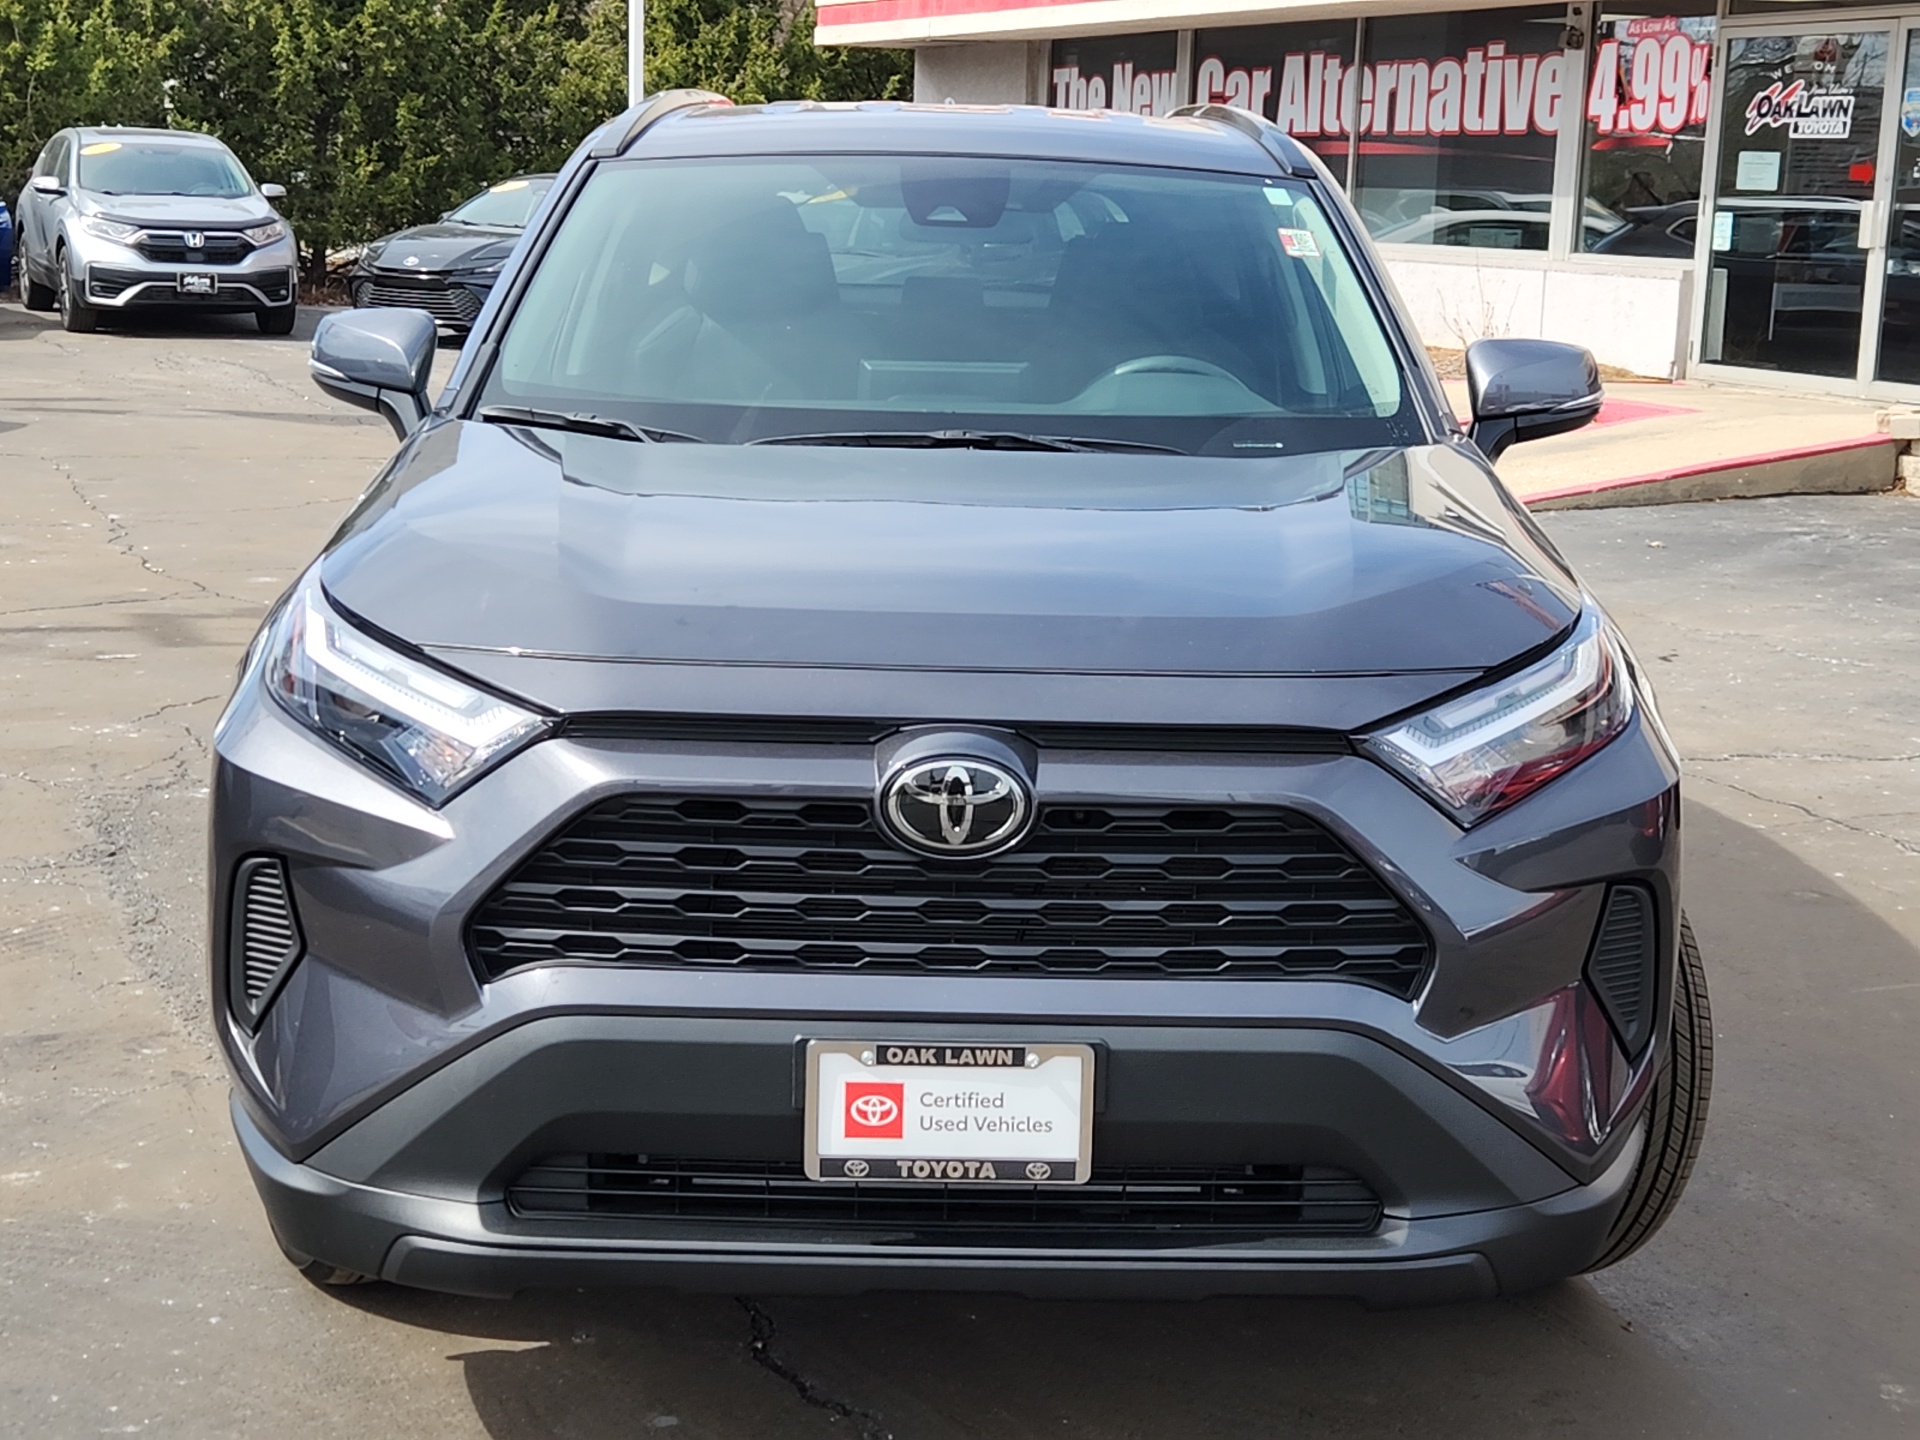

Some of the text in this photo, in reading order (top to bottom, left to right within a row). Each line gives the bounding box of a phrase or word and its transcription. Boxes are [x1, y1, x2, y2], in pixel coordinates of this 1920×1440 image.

[1628, 19, 1676, 34] As Low As
[1053, 42, 1564, 133] The New Car Alternative
[1587, 34, 1710, 131] 4.99%
[1797, 121, 1845, 135] TOYOTA
[886, 1047, 1014, 1066] OAK LAWN
[919, 1091, 1005, 1110] Certified
[919, 1115, 1054, 1134] Used Vehicles
[896, 1160, 997, 1180] TOYOTA
